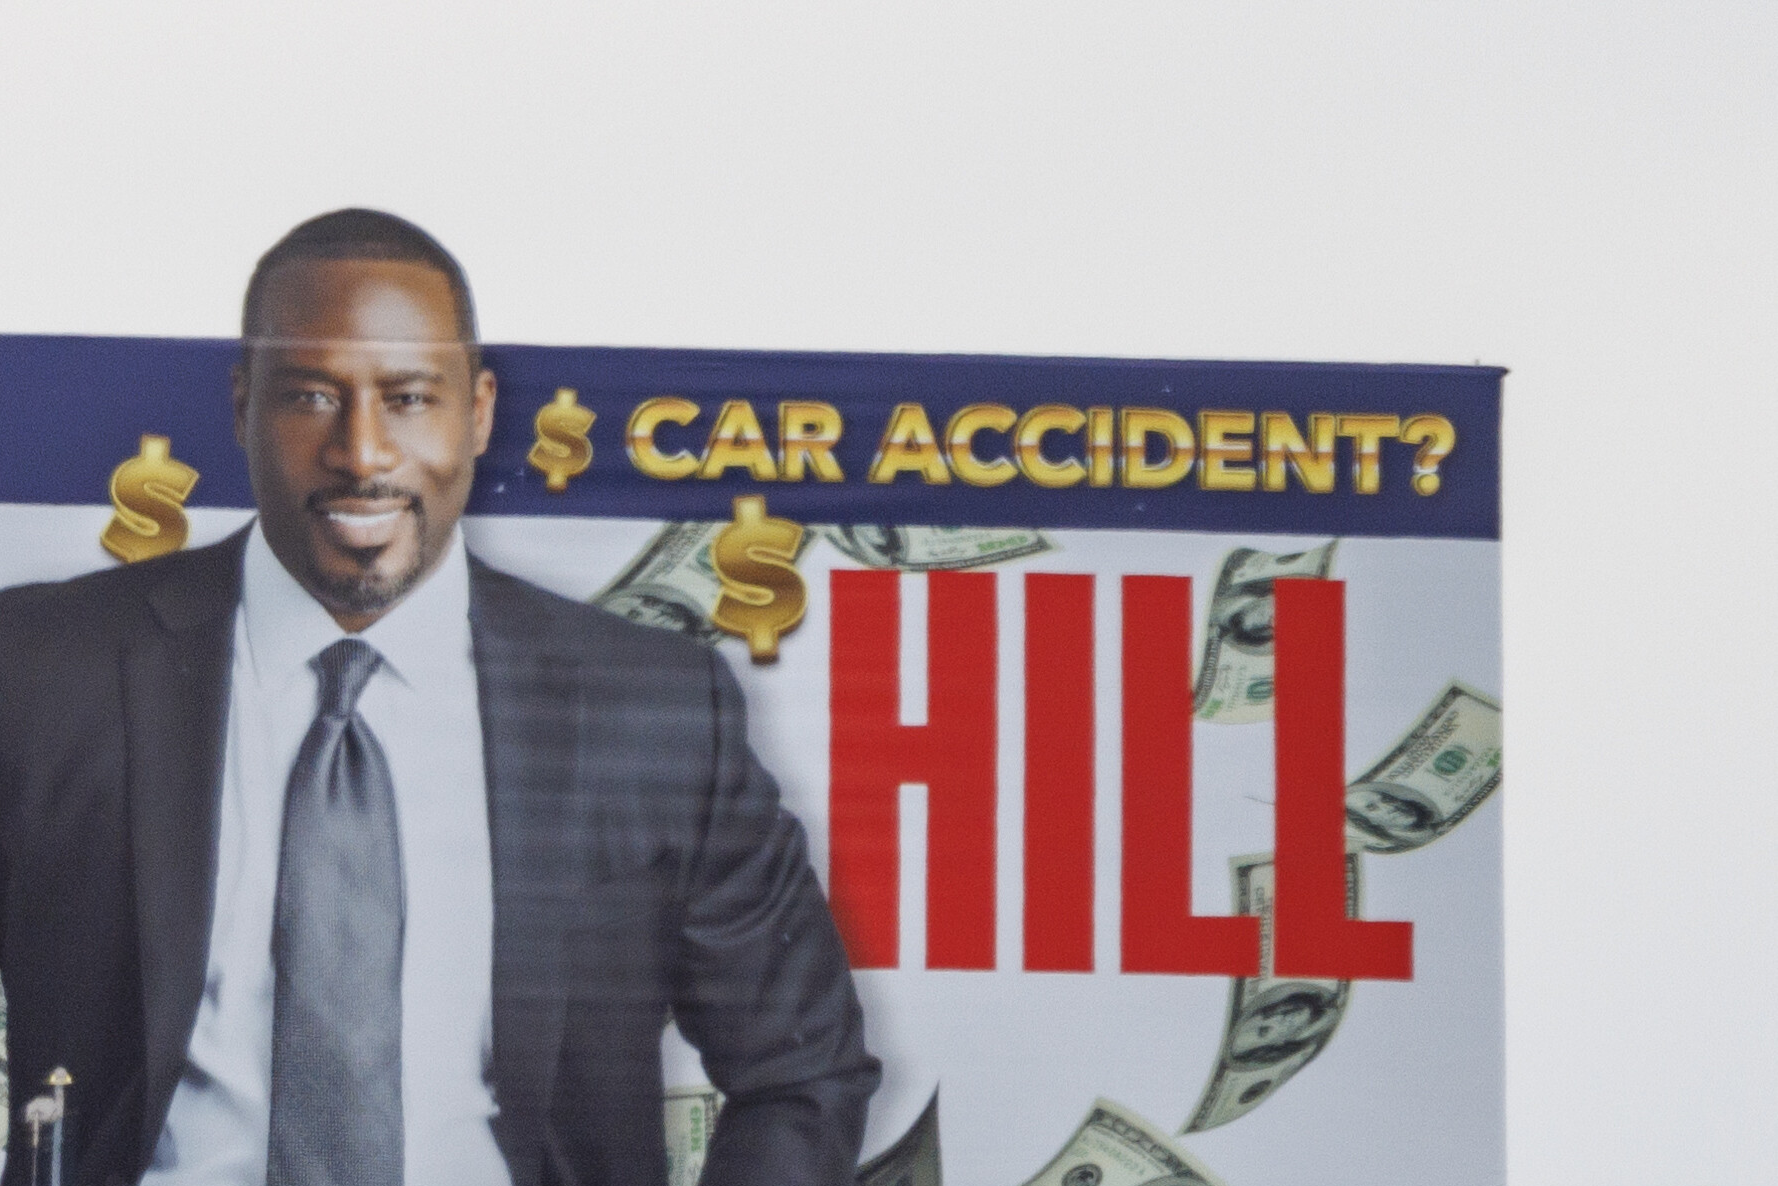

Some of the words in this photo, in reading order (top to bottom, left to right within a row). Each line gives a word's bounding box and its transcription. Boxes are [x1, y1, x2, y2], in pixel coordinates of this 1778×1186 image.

[626, 396, 845, 483] CAR
[868, 402, 1457, 496] ACCIDENT?
[828, 568, 1413, 981] HILL
